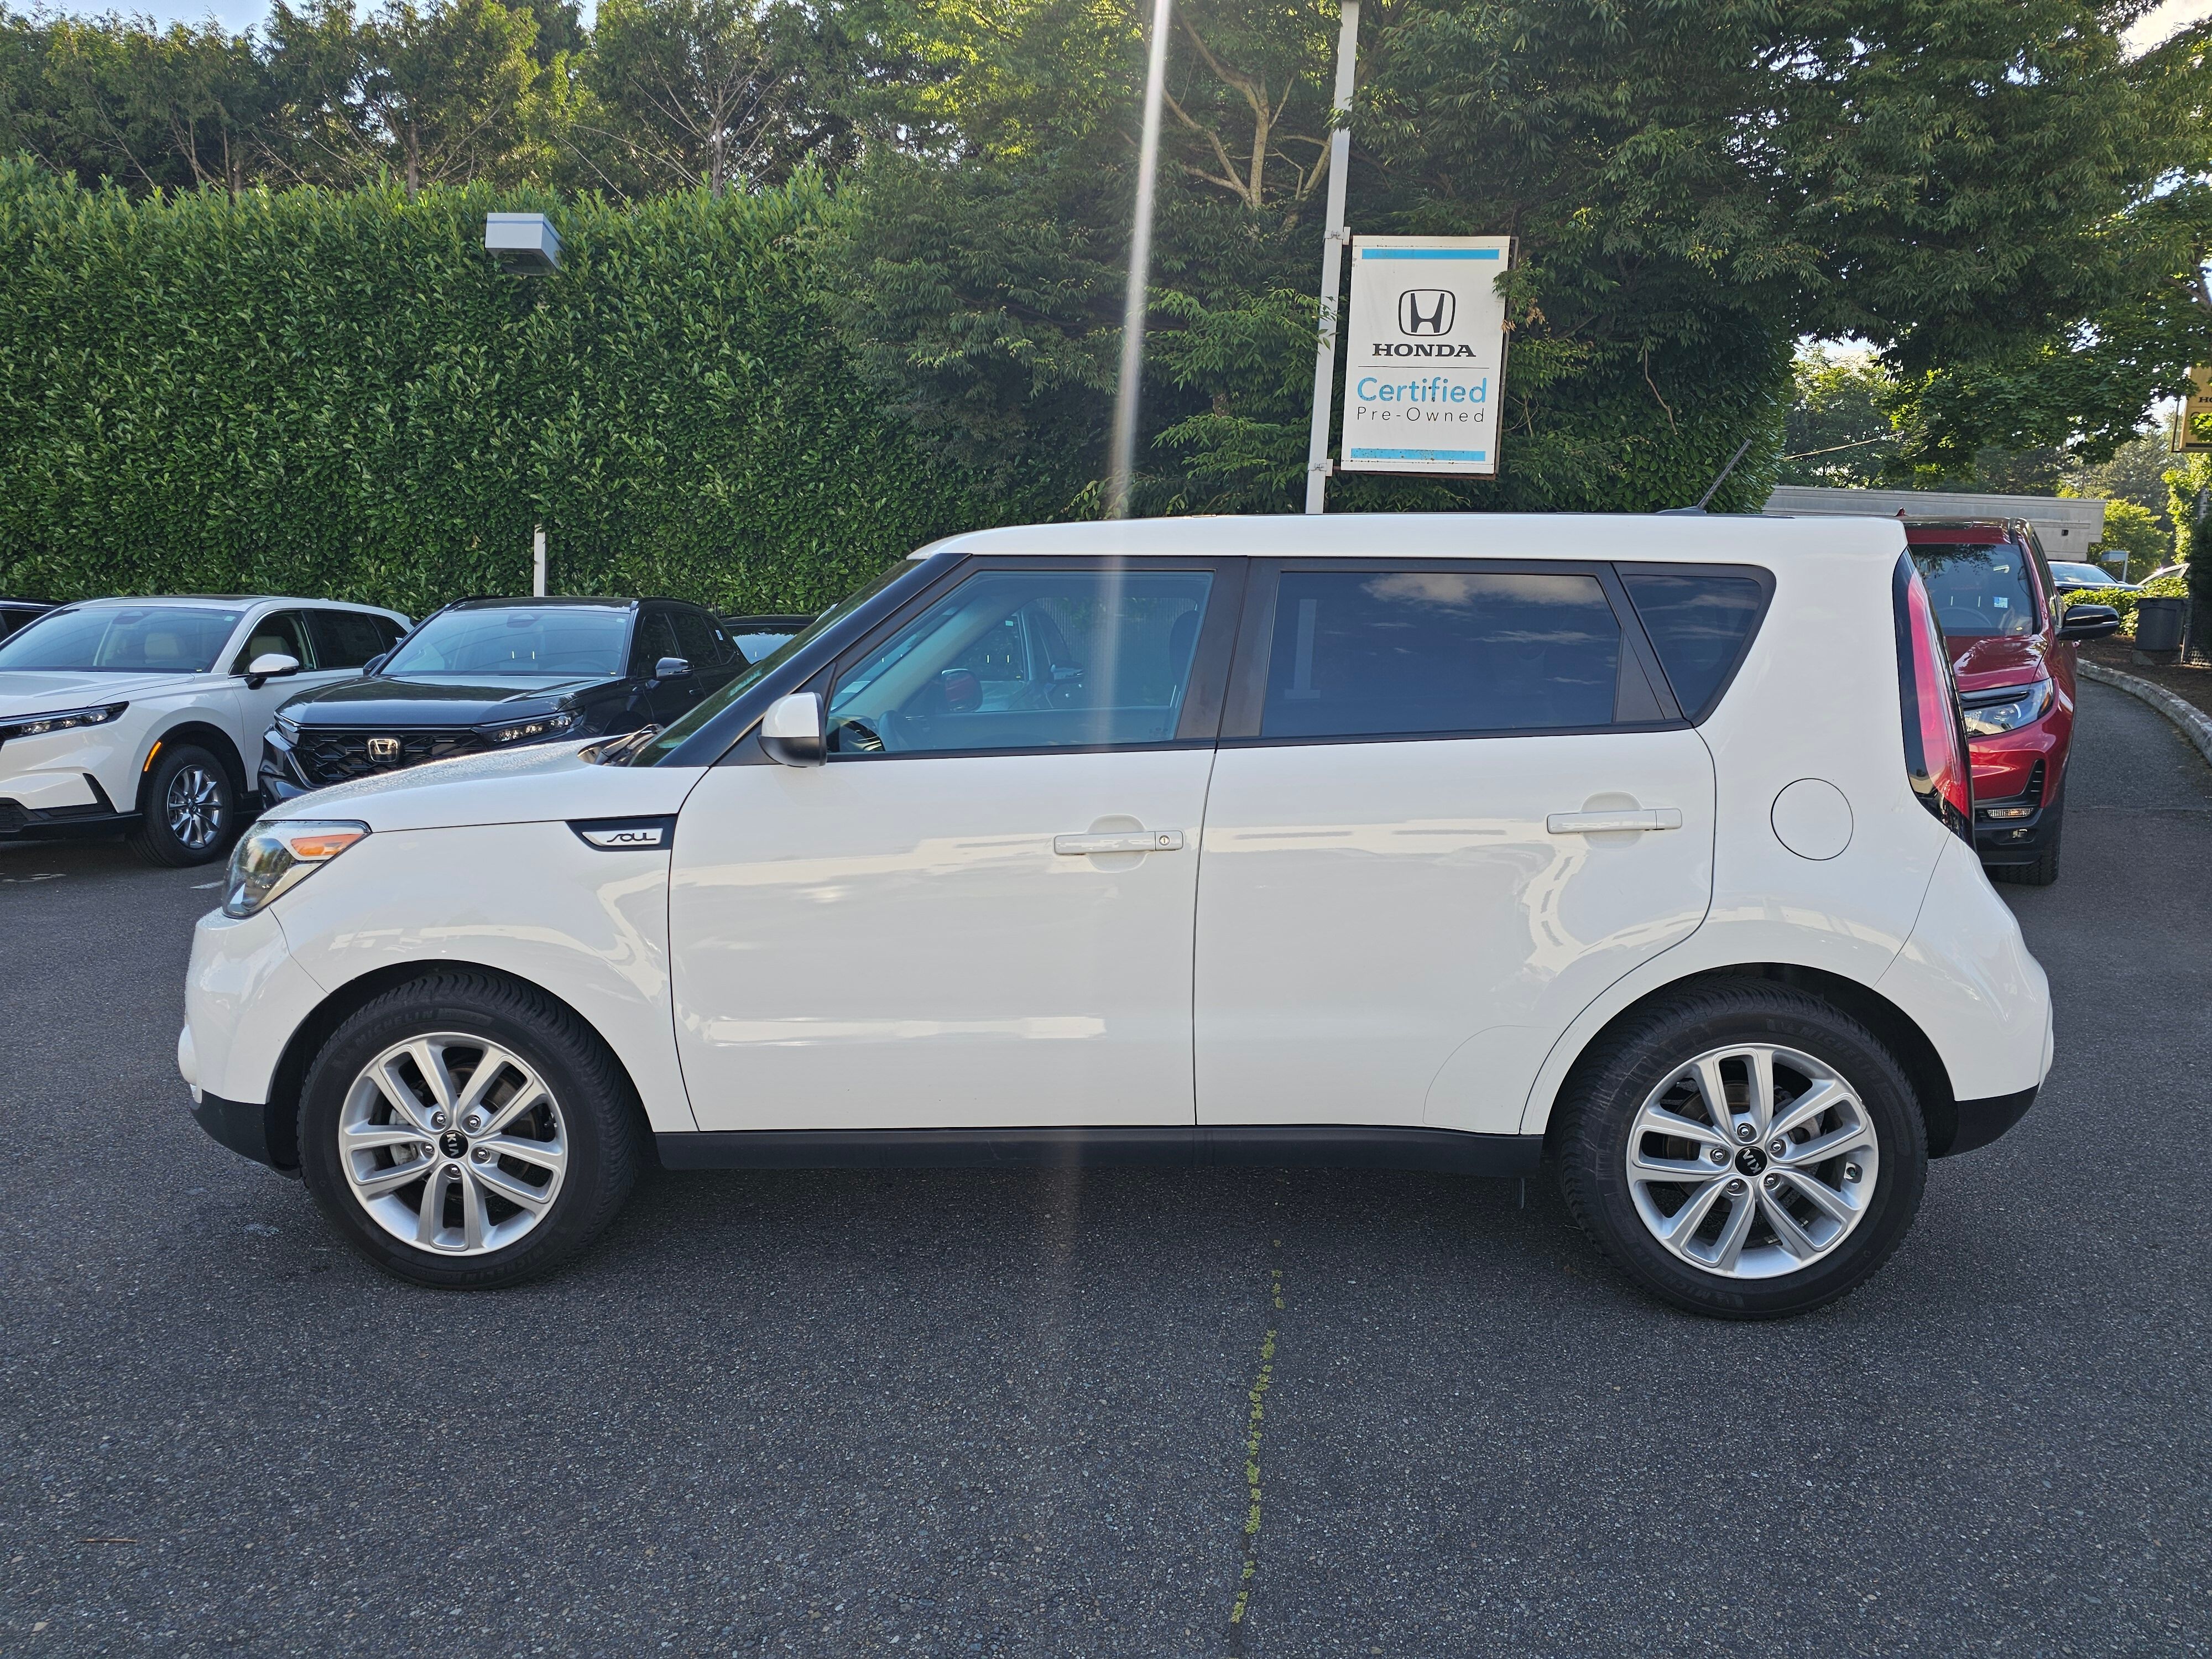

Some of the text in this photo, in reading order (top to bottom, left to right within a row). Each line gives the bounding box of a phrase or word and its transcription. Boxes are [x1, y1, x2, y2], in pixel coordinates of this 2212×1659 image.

[1372, 343, 1477, 357] HONDA
[1357, 377, 1487, 403] Certified
[1357, 406, 1484, 422] Pre-Owned
[355, 1009, 434, 1046] MICHELIN
[1800, 1027, 1882, 1081] MICHELIN
[446, 1133, 460, 1157] KIA
[1743, 1149, 1762, 1174] KIA
